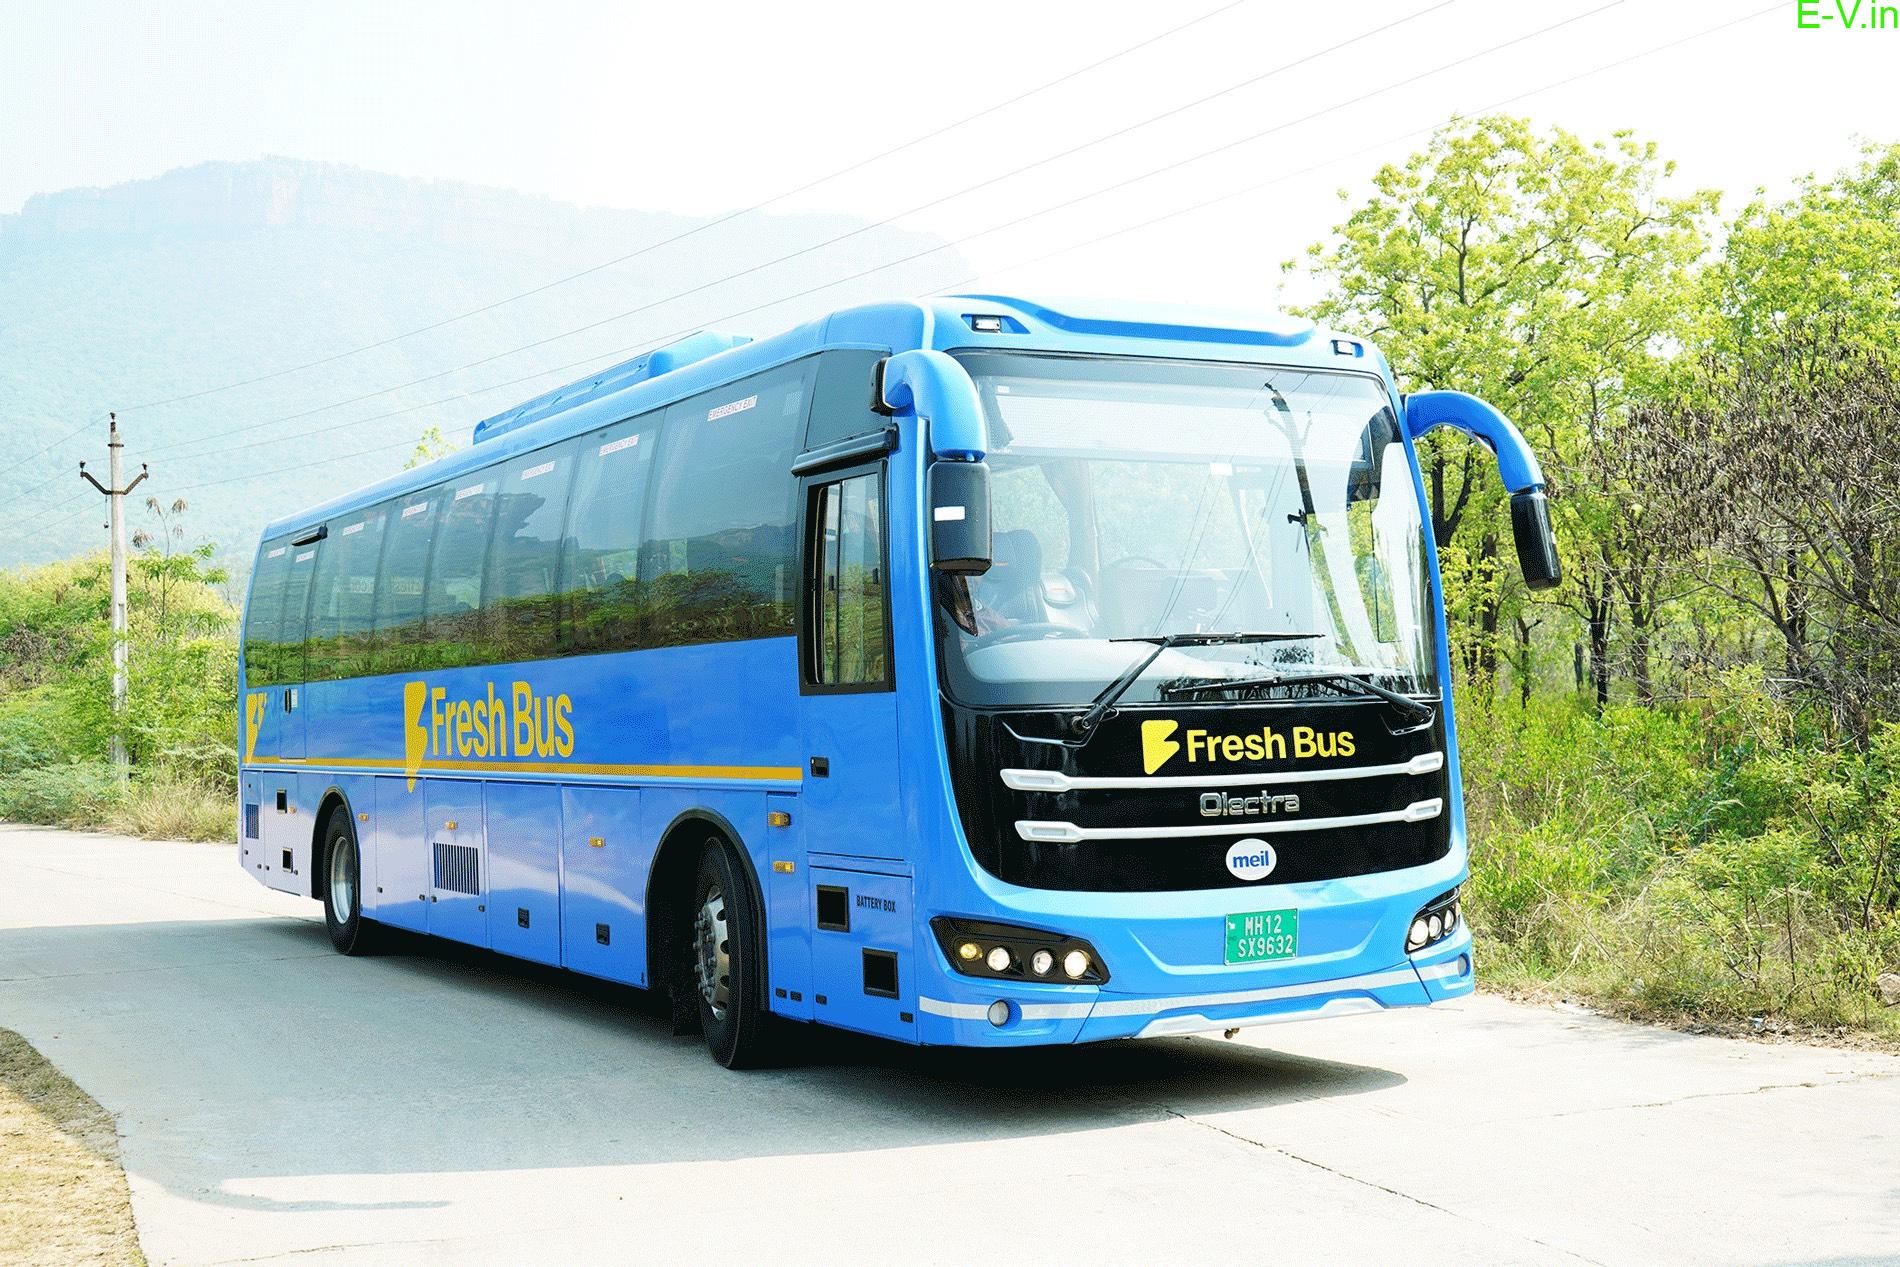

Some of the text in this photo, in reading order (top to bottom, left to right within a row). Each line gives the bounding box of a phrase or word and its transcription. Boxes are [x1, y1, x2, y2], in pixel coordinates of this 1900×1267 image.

[709, 401, 742, 418] EMERGENCY
[431, 681, 575, 758] Fresh Bus
[1186, 726, 1356, 762] Fresh Bus
[1200, 790, 1300, 817] Olectra
[1232, 850, 1269, 868] meil
[856, 895, 896, 913] BATTERY BOX
[1245, 914, 1282, 936] MH12
[1238, 934, 1293, 957] SX9632
